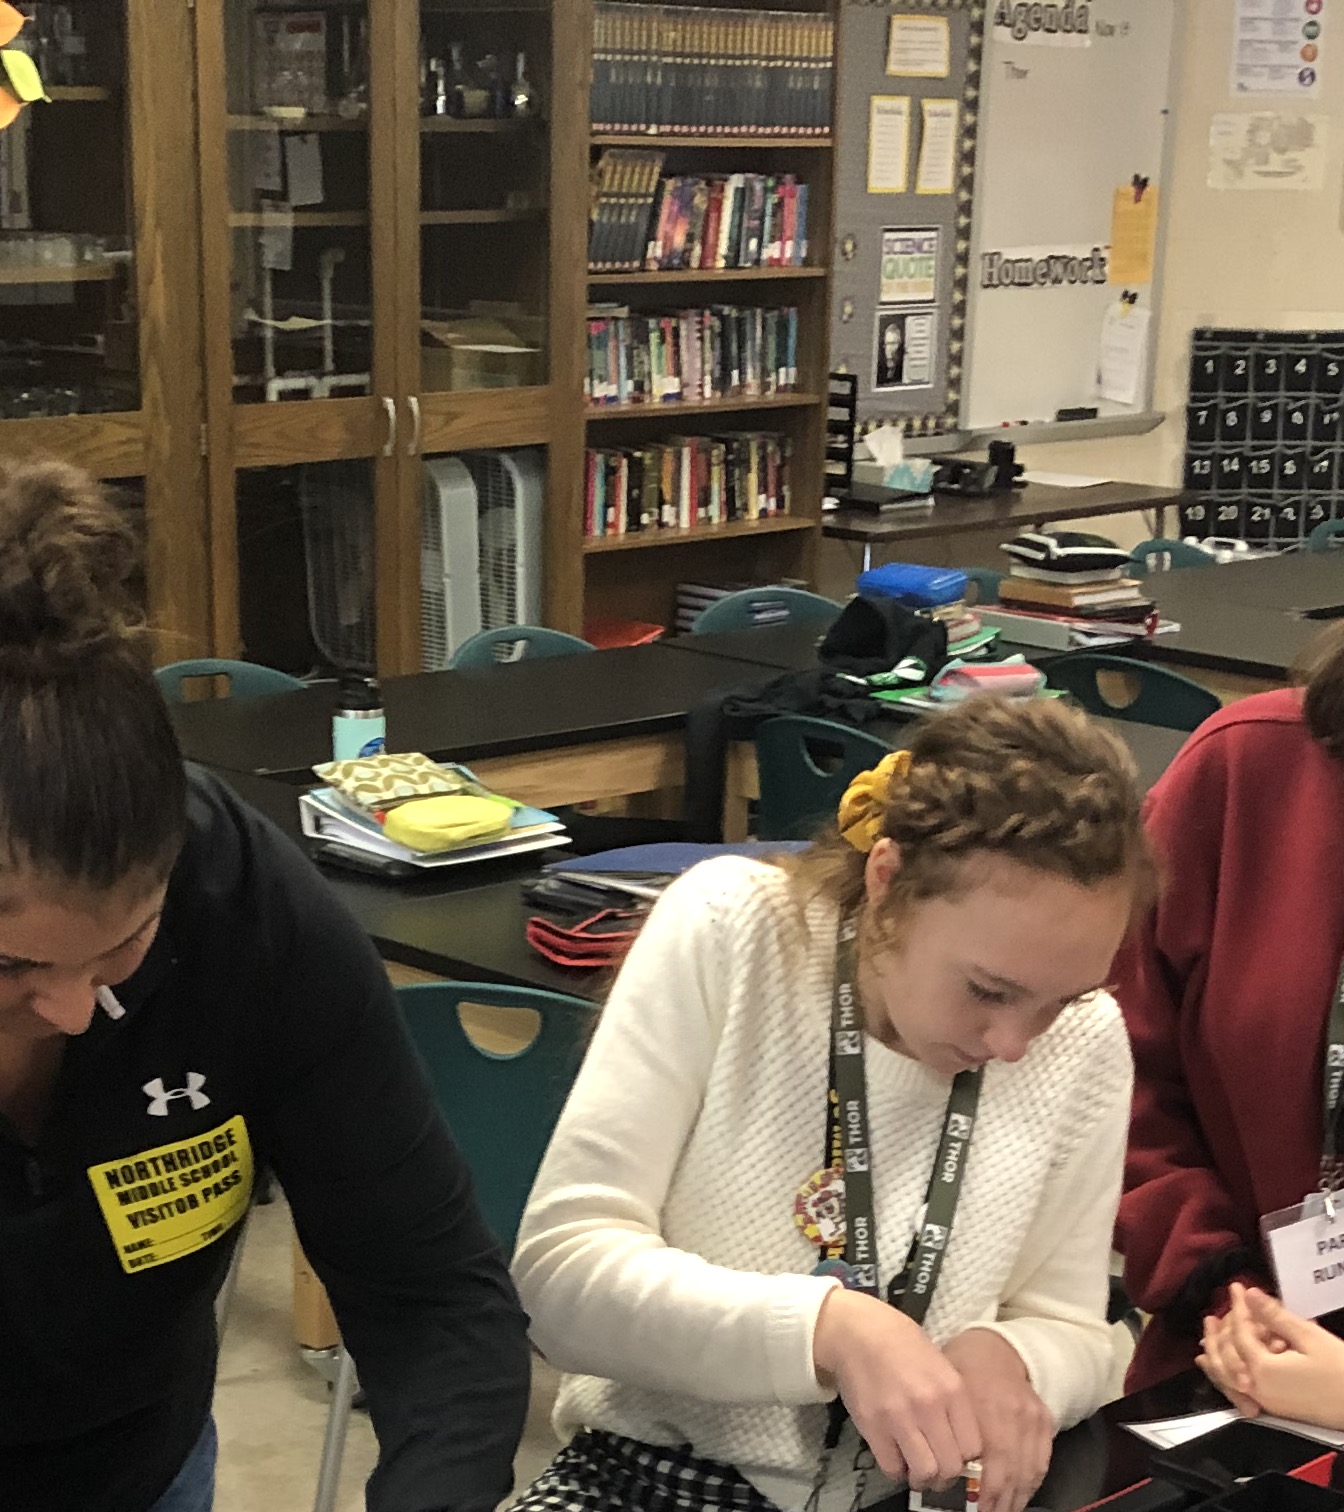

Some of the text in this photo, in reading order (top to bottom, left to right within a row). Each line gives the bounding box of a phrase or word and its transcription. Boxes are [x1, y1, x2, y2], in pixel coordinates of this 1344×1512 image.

[994, 0, 1090, 41] Agenda
[1205, 359, 1215, 375] 1
[1234, 359, 1247, 376] 2
[1264, 358, 1278, 375] 3
[1294, 358, 1307, 375] 4
[1326, 362, 1340, 377] 5
[1197, 410, 1208, 426] 7
[1225, 410, 1239, 427] 8
[1259, 409, 1273, 424] 9
[1191, 458, 1212, 475] 13
[1221, 457, 1240, 473] 14
[1248, 458, 1271, 475] 15
[1250, 506, 1271, 522] 21
[838, 982, 853, 1029] THOR
[846, 1099, 862, 1146] THOR
[104, 1127, 238, 1190] NORTHRIDGE
[116, 1149, 239, 1207] MIDDLE SCHOOL
[941, 1141, 962, 1184] THOR
[126, 1169, 243, 1230] VISITOR PASS
[853, 1216, 870, 1261] THOR
[913, 1251, 938, 1295] THOR
